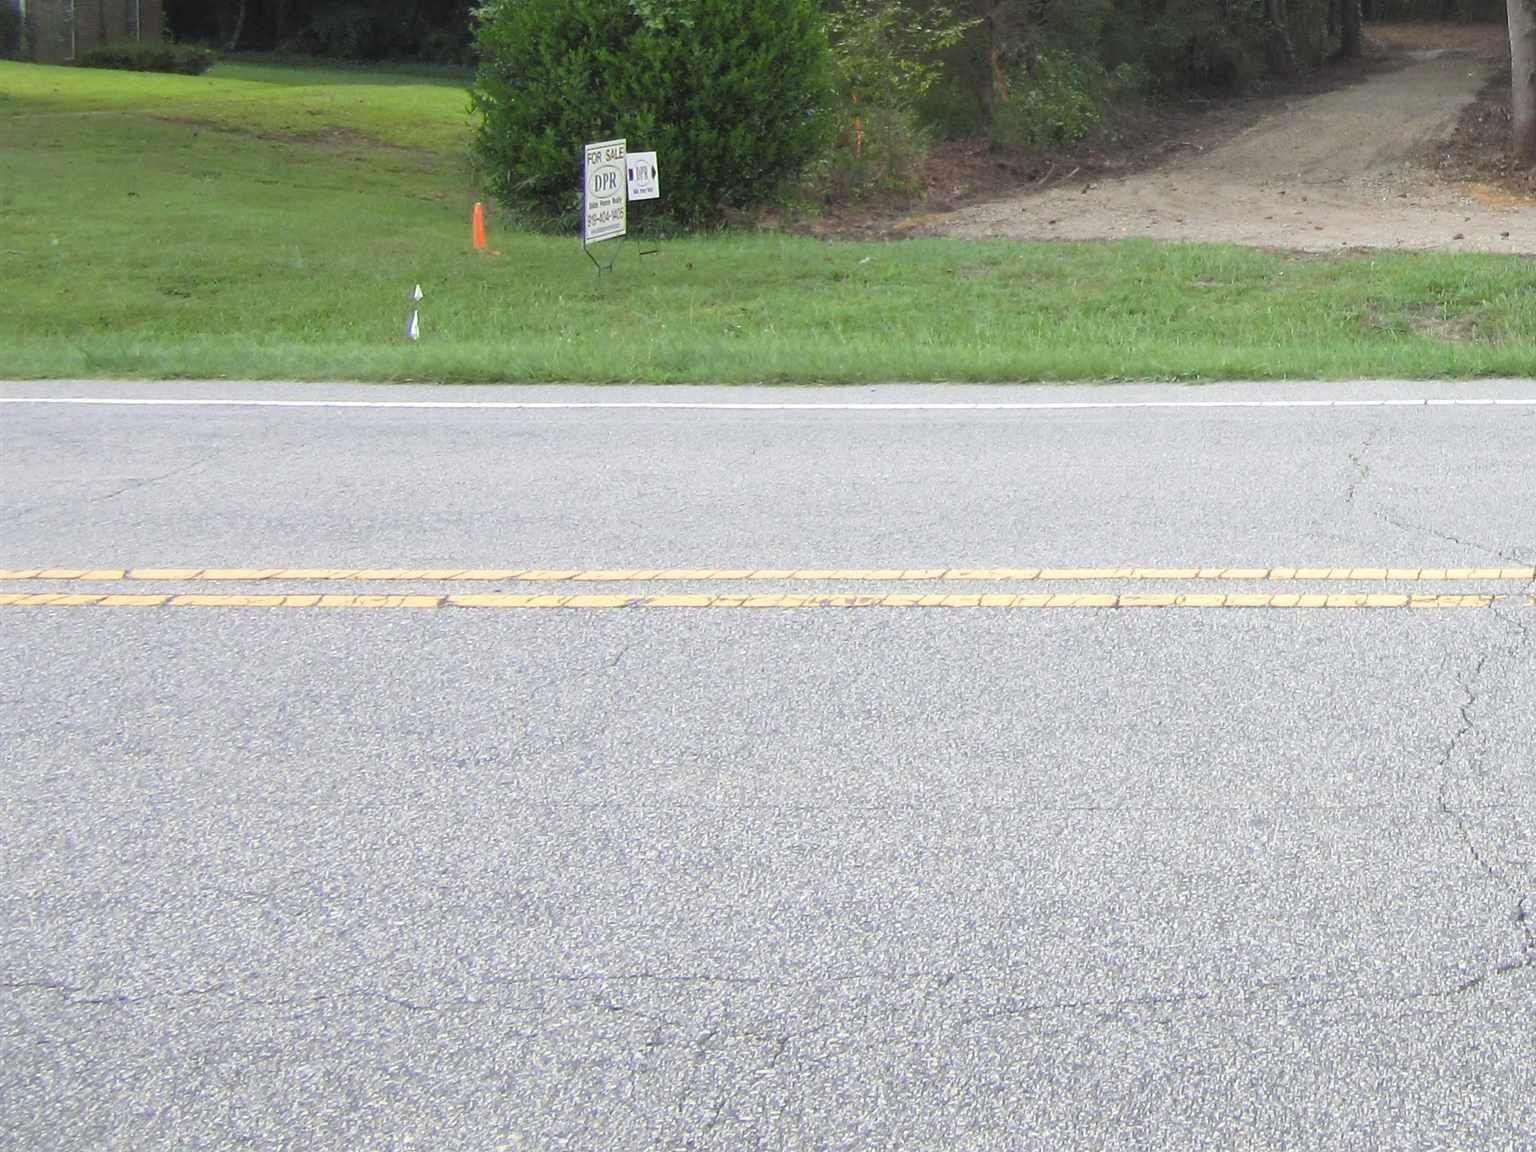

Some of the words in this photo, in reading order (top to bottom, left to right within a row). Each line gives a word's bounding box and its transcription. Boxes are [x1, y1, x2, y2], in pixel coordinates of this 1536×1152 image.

[587, 151, 602, 165] FOR
[605, 147, 624, 162] SALE
[595, 172, 617, 192] DPR
